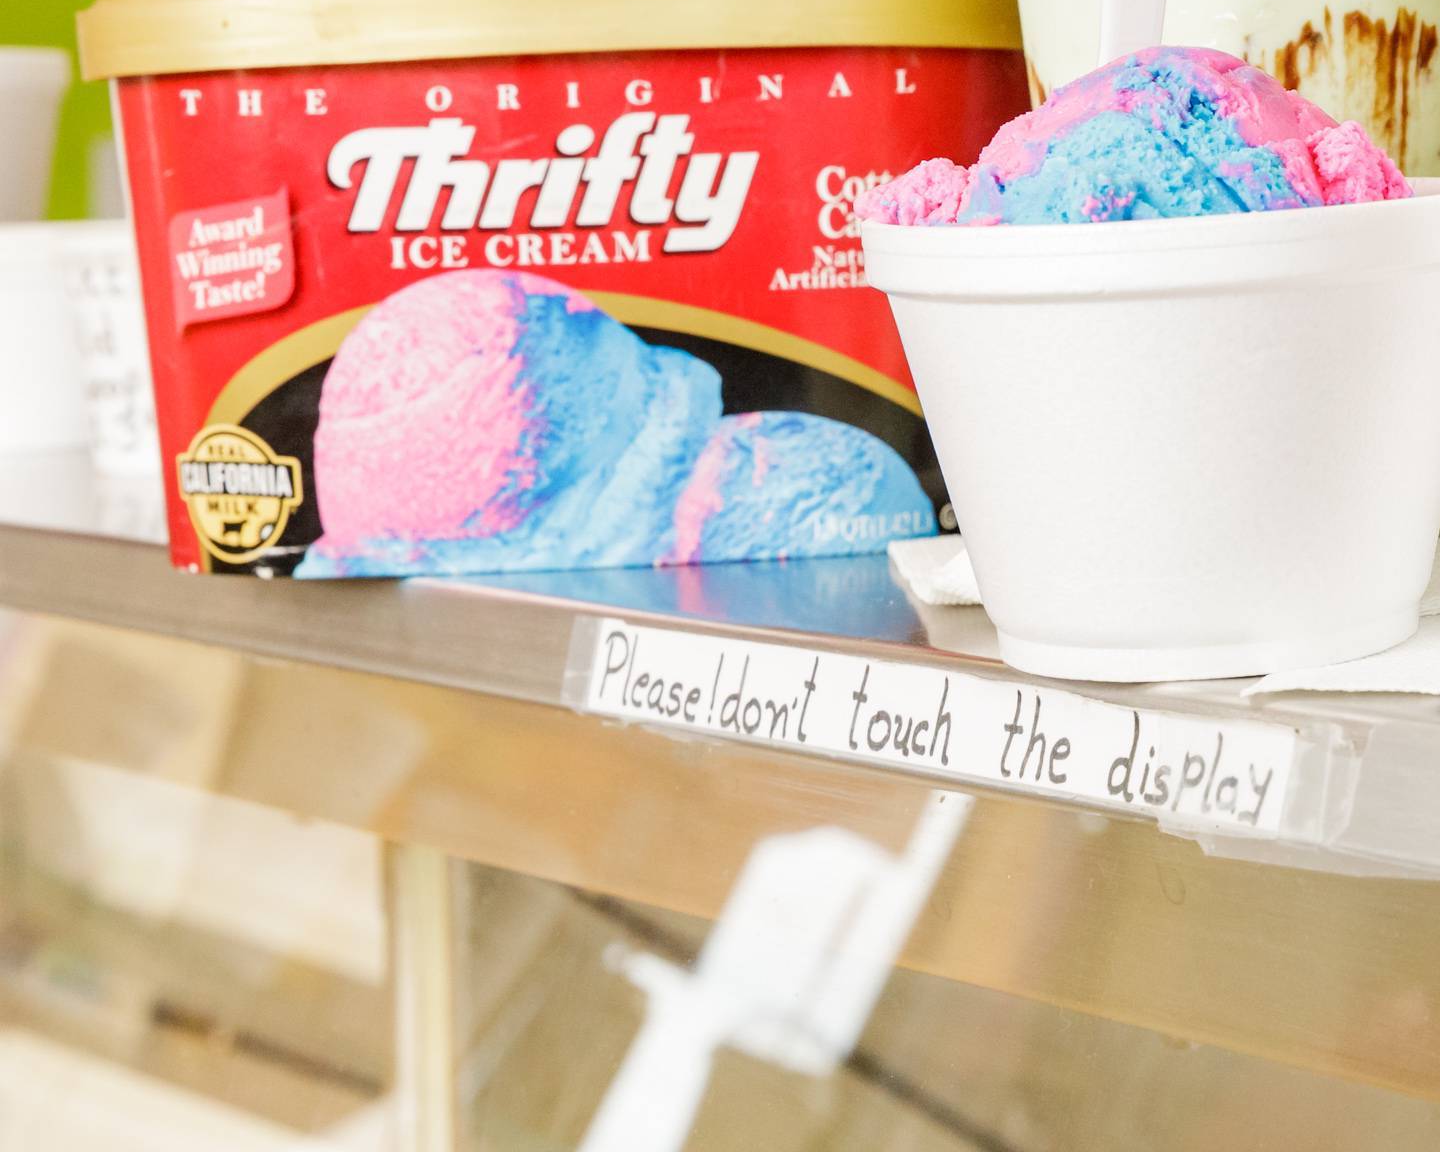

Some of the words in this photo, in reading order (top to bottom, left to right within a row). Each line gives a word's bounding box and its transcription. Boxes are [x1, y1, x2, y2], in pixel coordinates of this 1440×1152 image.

[180, 89, 328, 116] THE
[426, 68, 916, 112] ORIGINAL
[328, 111, 759, 252] Thrifty
[188, 206, 264, 247] Award
[176, 241, 282, 279] Winning
[391, 236, 467, 269] ICE
[485, 230, 652, 268] CREAM
[189, 272, 266, 309] Taste!
[769, 267, 869, 290] Artificia
[207, 499, 258, 515] MILK
[847, 663, 952, 767] touch
[1000, 689, 1072, 784] the
